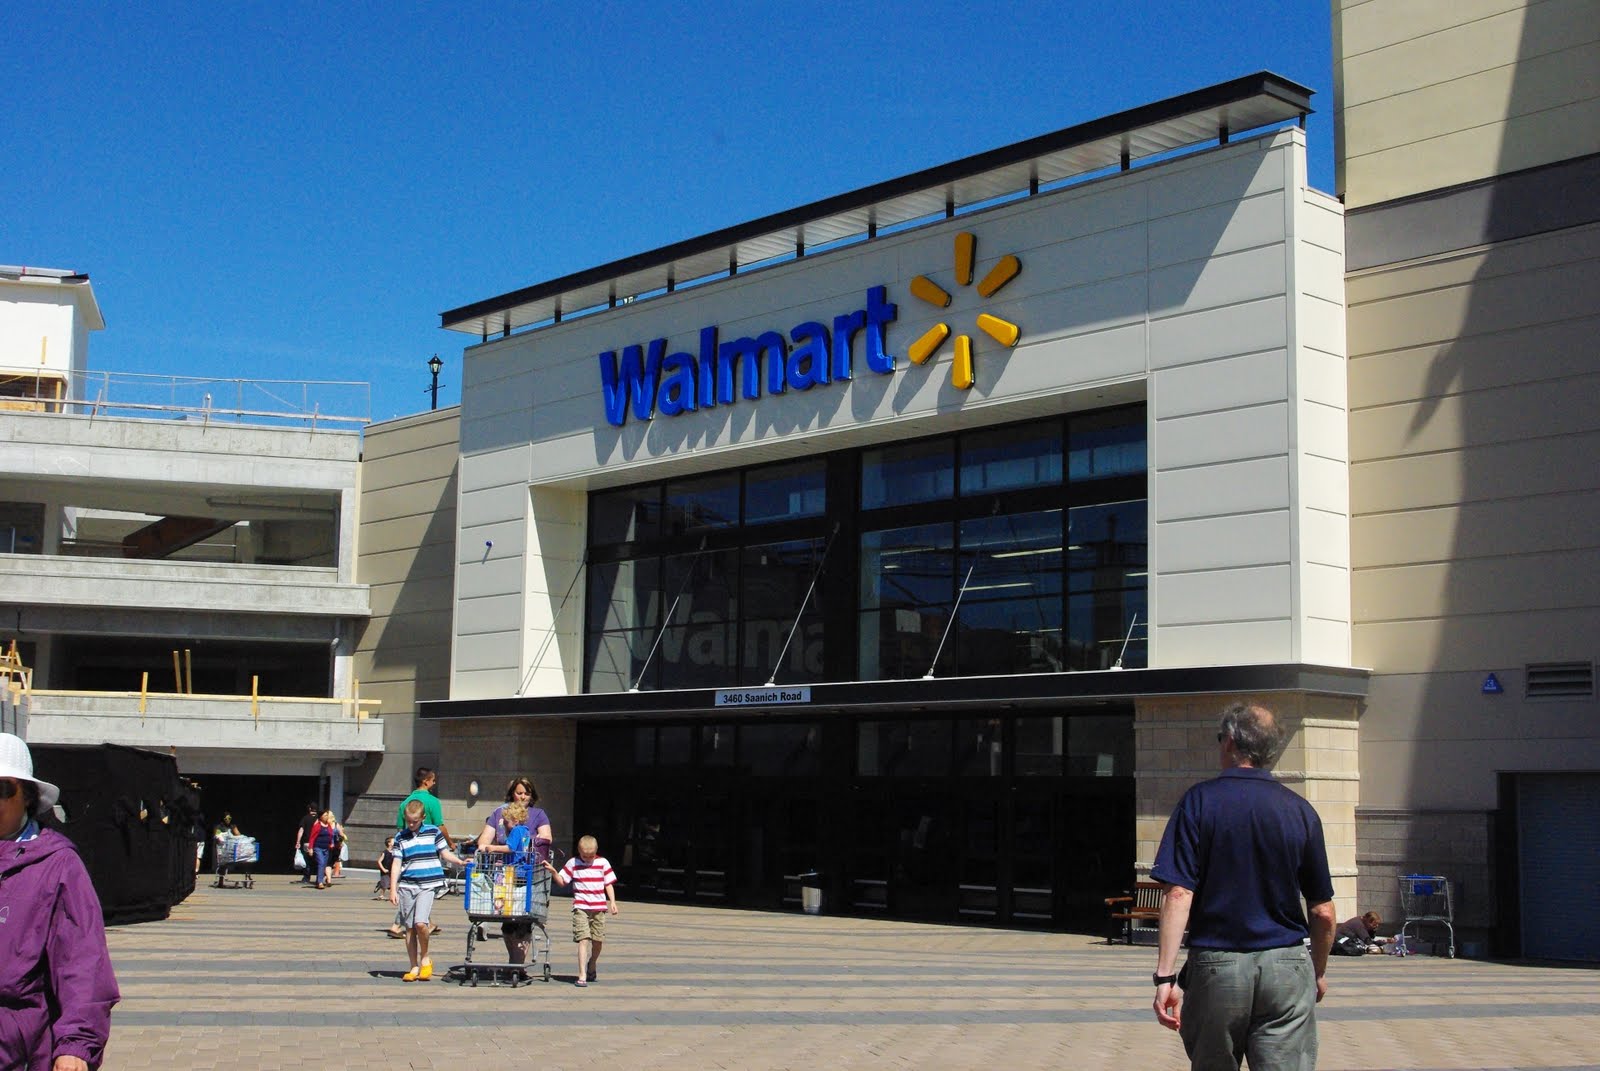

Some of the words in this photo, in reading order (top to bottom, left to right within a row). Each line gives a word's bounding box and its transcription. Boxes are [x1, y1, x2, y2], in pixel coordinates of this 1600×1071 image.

[599, 285, 898, 427] Walmart
[723, 693, 743, 704] 3460
[745, 692, 778, 703] Saanich
[780, 691, 802, 701] Road
